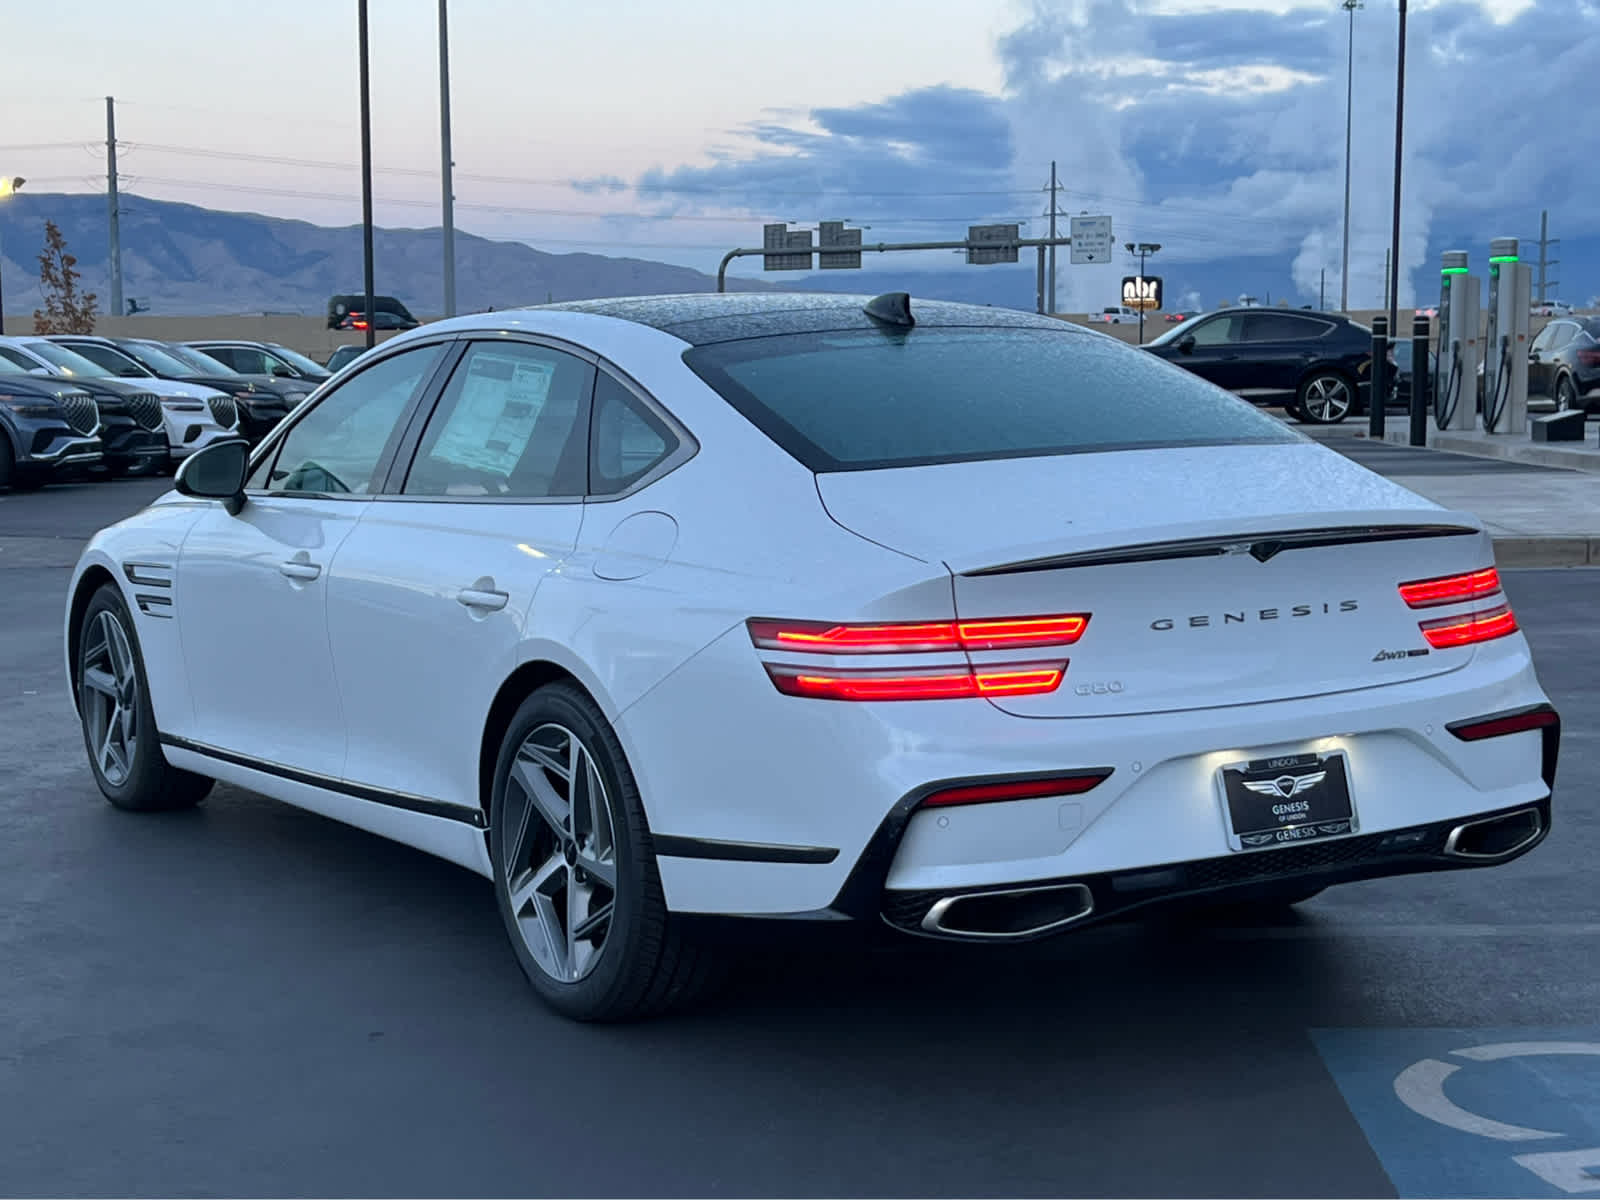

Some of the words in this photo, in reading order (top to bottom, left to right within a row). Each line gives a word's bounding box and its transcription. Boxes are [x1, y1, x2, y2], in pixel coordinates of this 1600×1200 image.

[1150, 600, 1358, 631] GENESIS
[1074, 680, 1125, 696] G80
[1272, 801, 1309, 814] GENESIS
[1276, 827, 1317, 840] GENESIS
